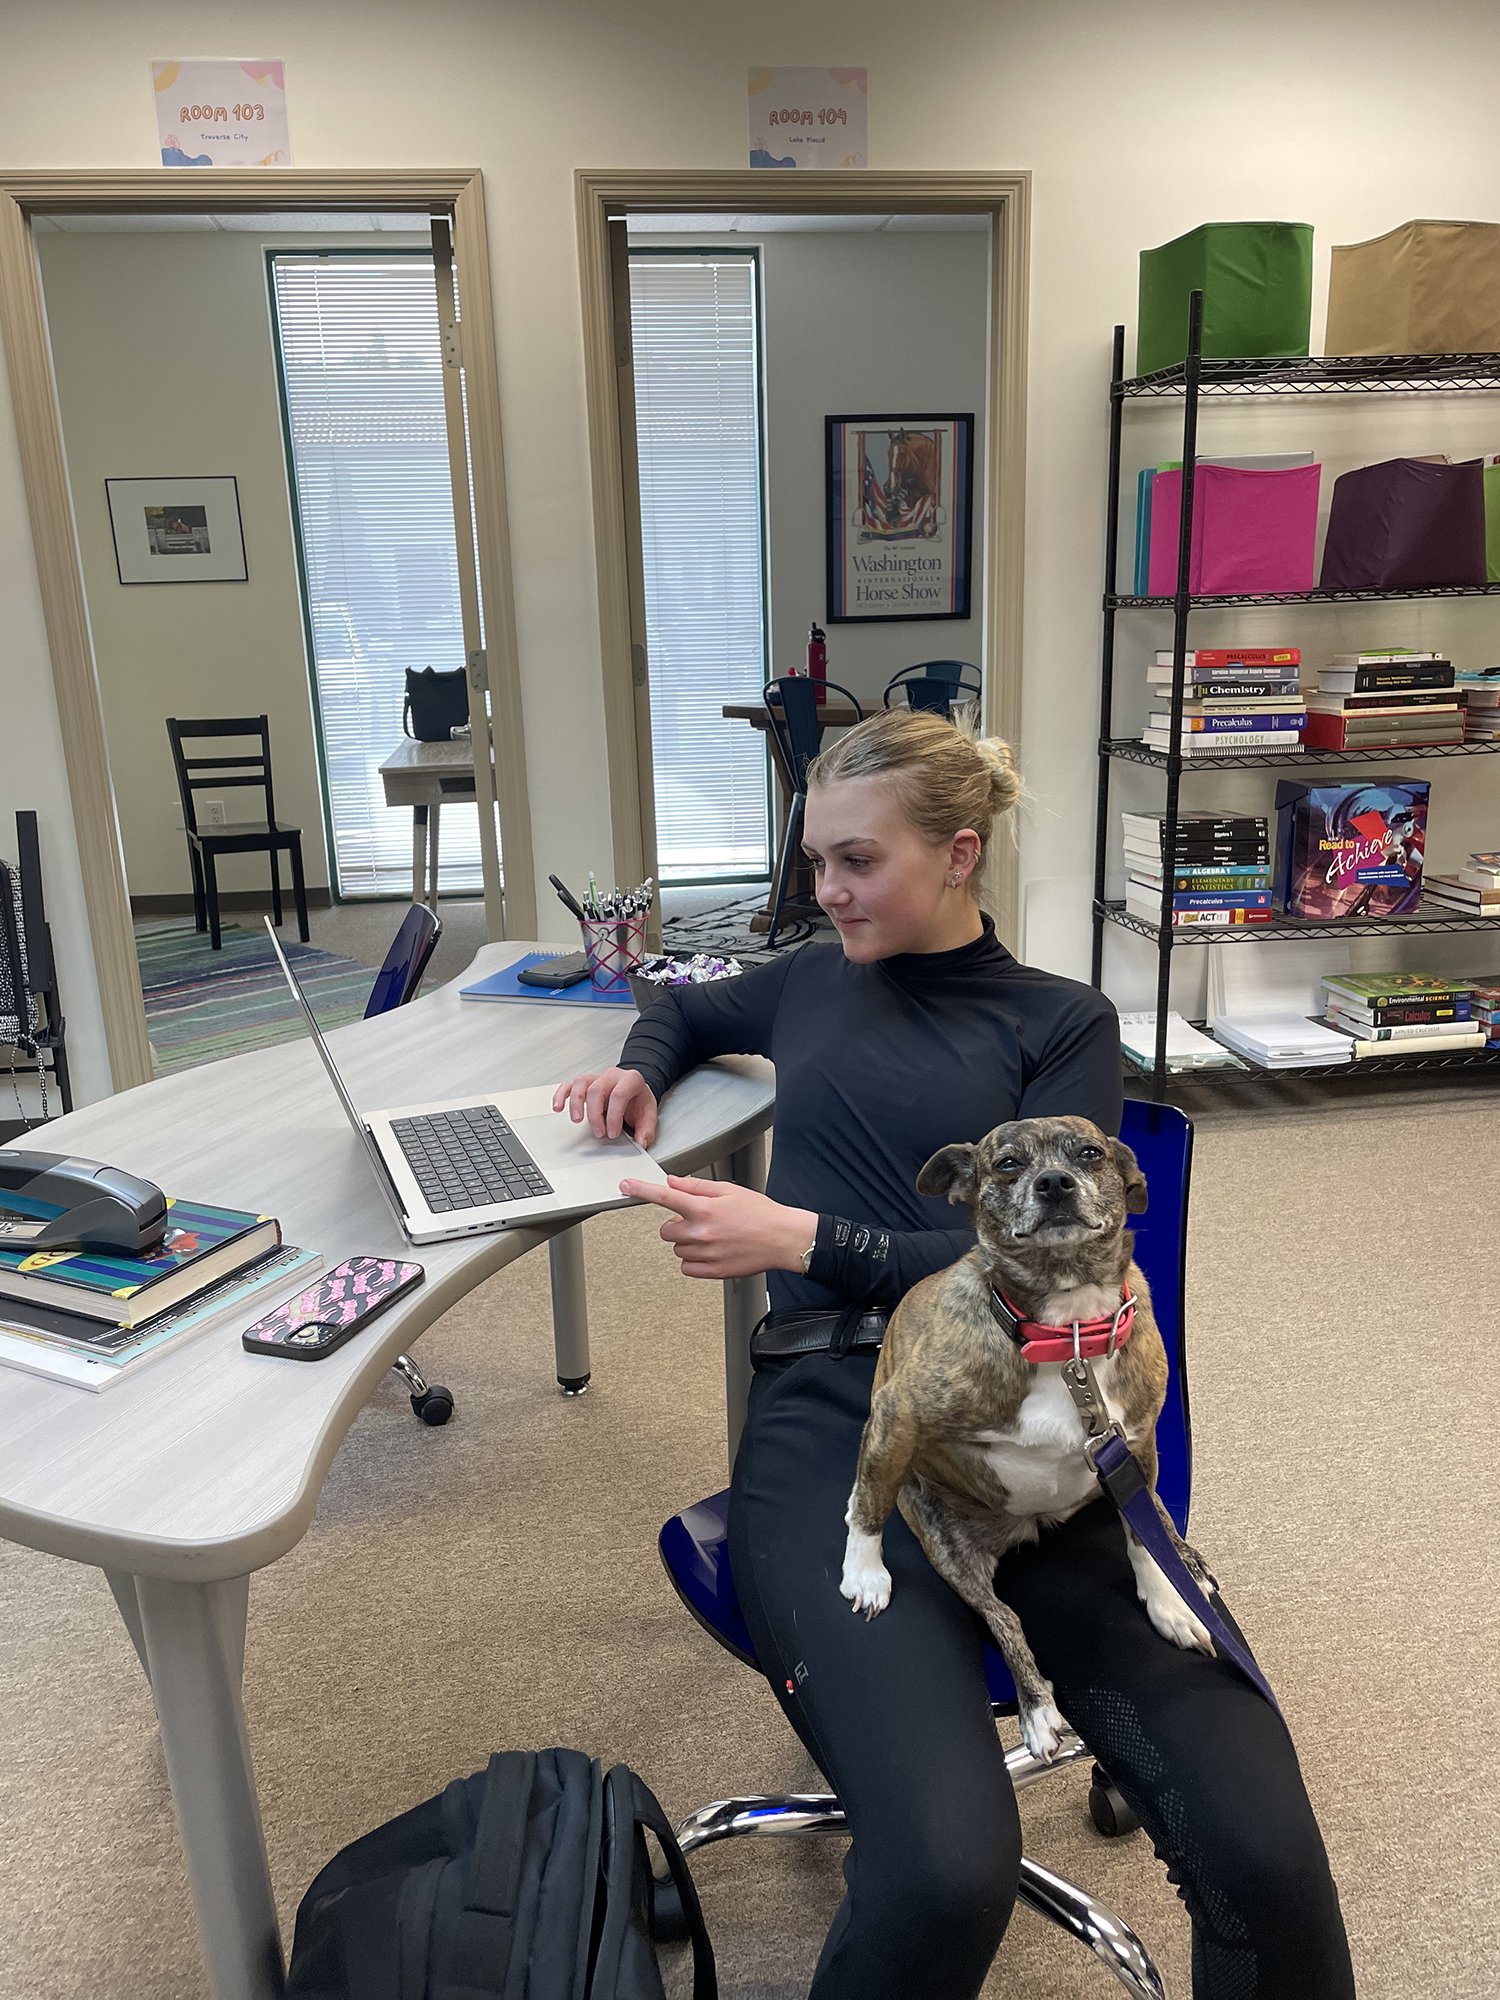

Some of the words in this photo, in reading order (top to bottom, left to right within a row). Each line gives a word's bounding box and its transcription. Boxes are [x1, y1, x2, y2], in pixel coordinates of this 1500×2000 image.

[180, 105, 228, 123] ROOM
[232, 104, 265, 121] 103
[769, 109, 814, 126] ROOM
[818, 108, 848, 125] 104
[233, 133, 248, 141] City
[852, 553, 942, 576] Washington
[863, 576, 934, 584] INTERNATIONAL
[856, 585, 898, 601] Horse
[902, 583, 941, 600] Show
[1209, 685, 1266, 694] Chemistry
[1212, 717, 1253, 727] Precalculus
[1215, 735, 1265, 745] PSYCHOLOGY
[1319, 839, 1343, 851] Read
[1345, 839, 1355, 849] to
[1325, 829, 1393, 884] Achieve
[1192, 867, 1226, 875] ALGEBRA
[1191, 883, 1234, 891] STATISTICS
[1189, 898, 1223, 906] Precalculus
[1199, 913, 1217, 922] ACT
[1388, 995, 1425, 1004] Environmental
[1404, 1009, 1431, 1022] Calculus
[1415, 1026, 1440, 1034] CALCULUS
